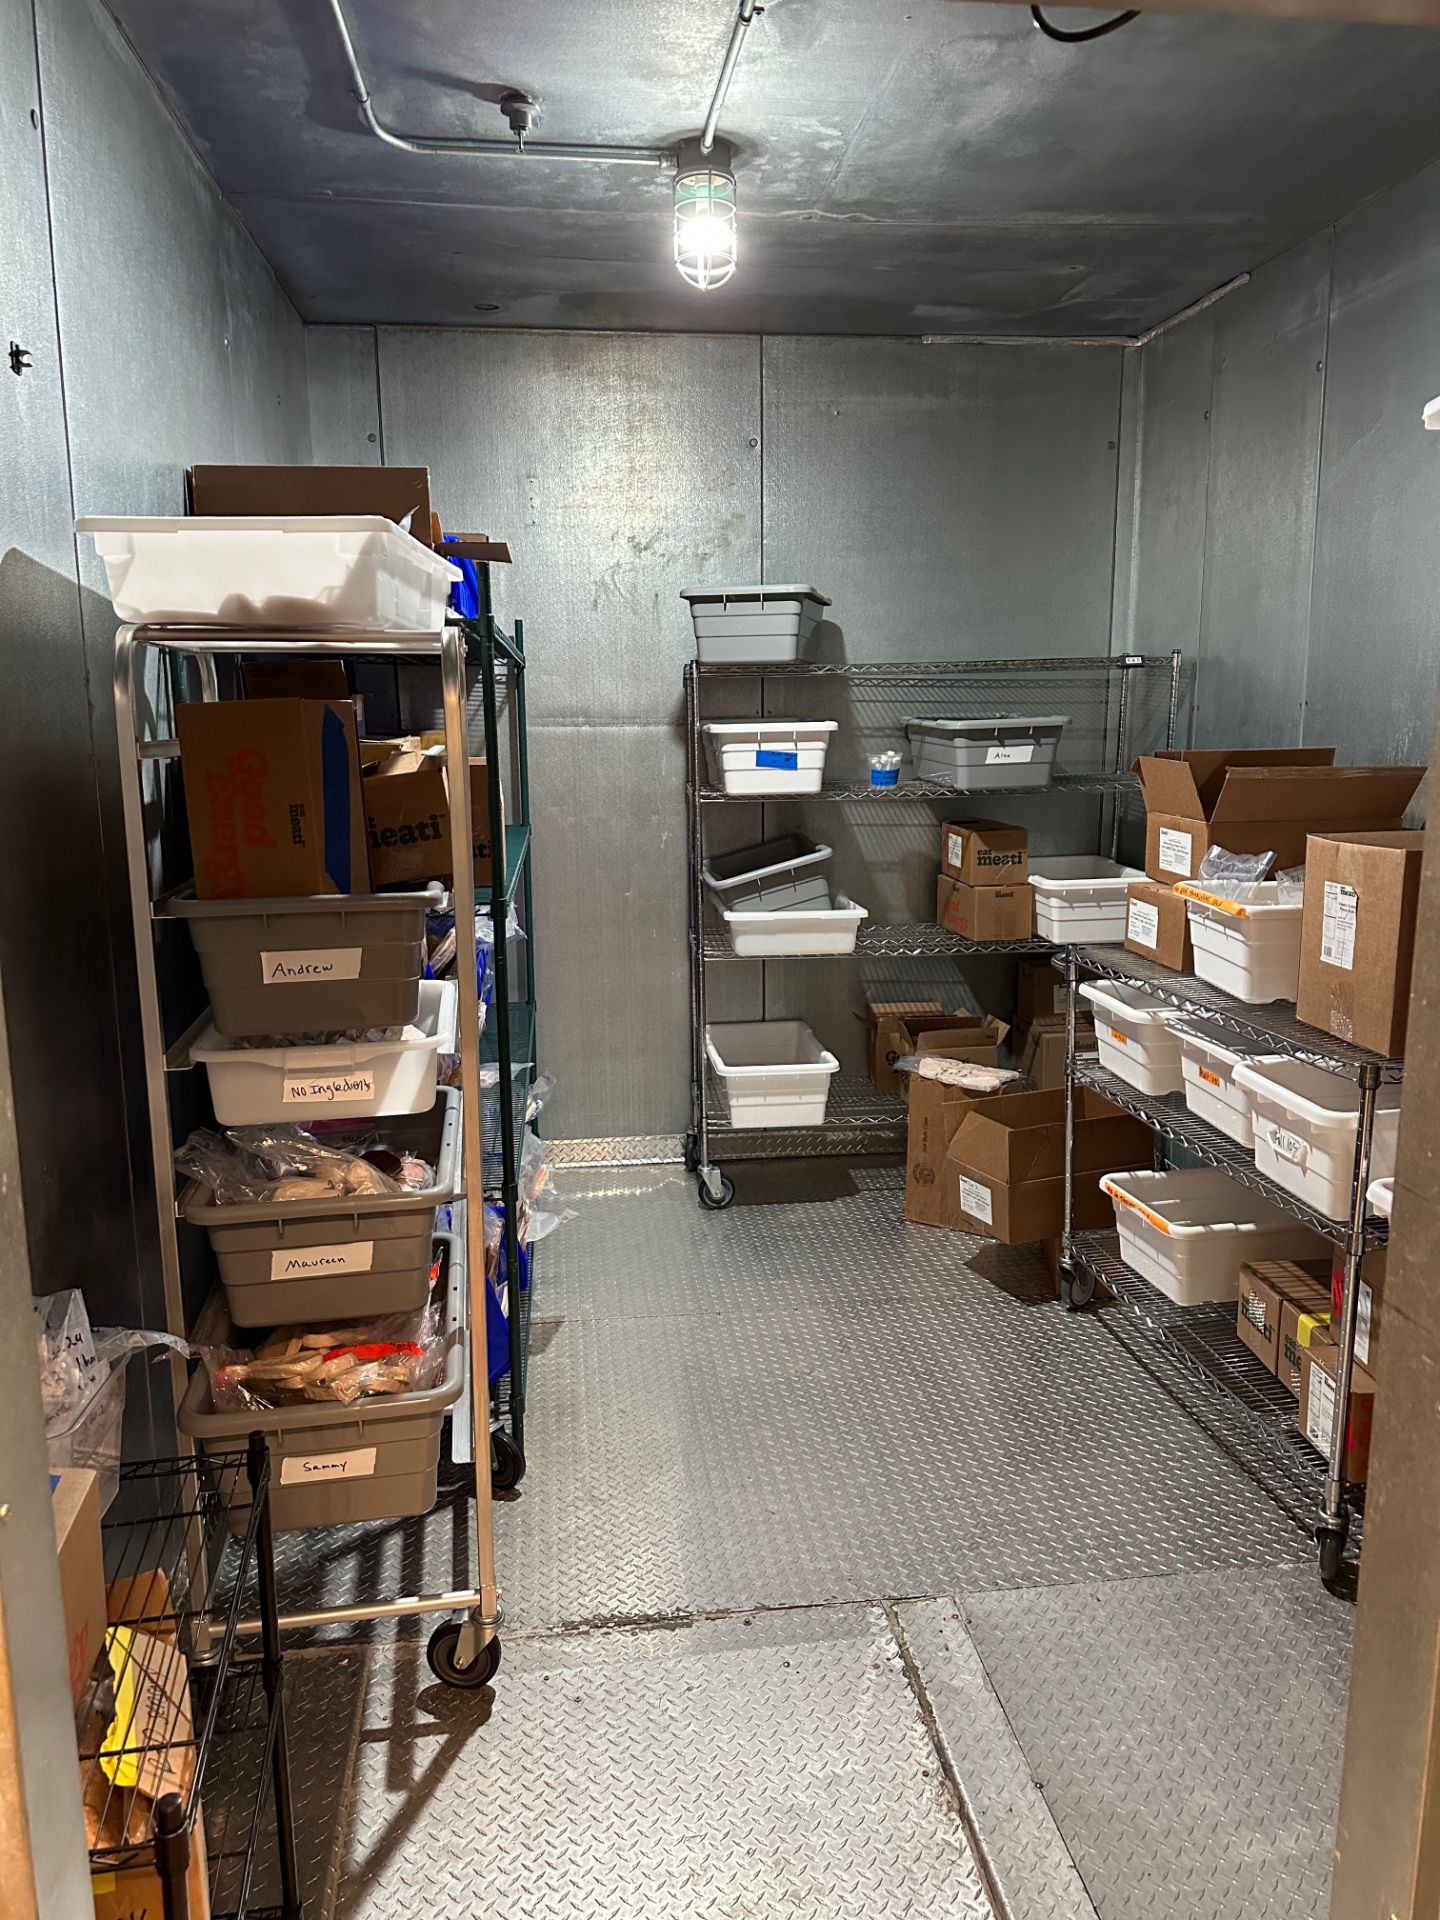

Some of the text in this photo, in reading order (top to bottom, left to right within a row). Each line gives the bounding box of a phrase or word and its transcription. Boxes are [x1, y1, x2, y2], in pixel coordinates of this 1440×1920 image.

[227, 748, 278, 849] Good
[289, 804, 305, 846] meati
[977, 851, 1023, 867] meati
[272, 962, 333, 978] Andrew
[285, 1257, 345, 1272] Maureen
[303, 1461, 347, 1472] Sammy
